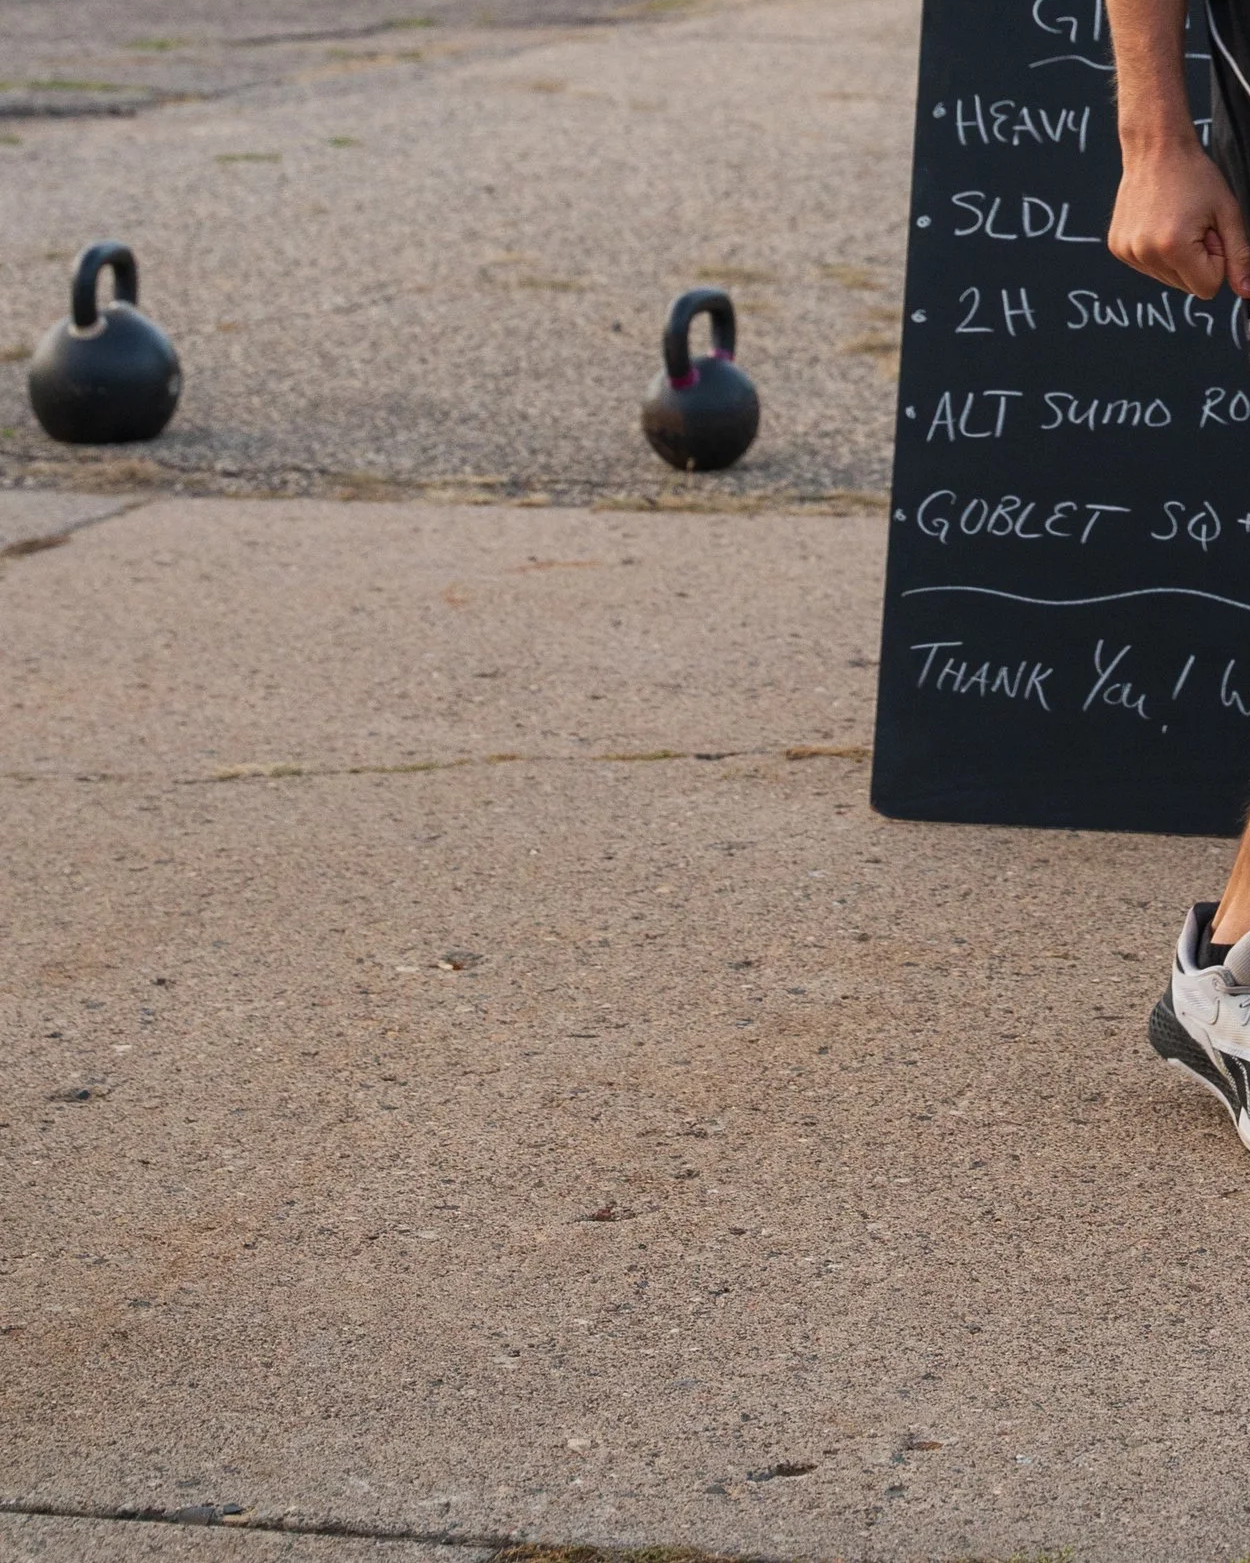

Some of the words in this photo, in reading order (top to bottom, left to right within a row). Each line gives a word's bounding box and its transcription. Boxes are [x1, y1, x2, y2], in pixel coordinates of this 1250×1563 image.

[956, 93, 1091, 154] HEAVY
[951, 190, 1102, 243] SLDL
[955, 286, 1037, 337] 2H
[925, 390, 1024, 442] ALT
[916, 489, 1132, 544] GOBLET
[1150, 500, 1222, 552] SQ
[910, 640, 1054, 713] THANK
